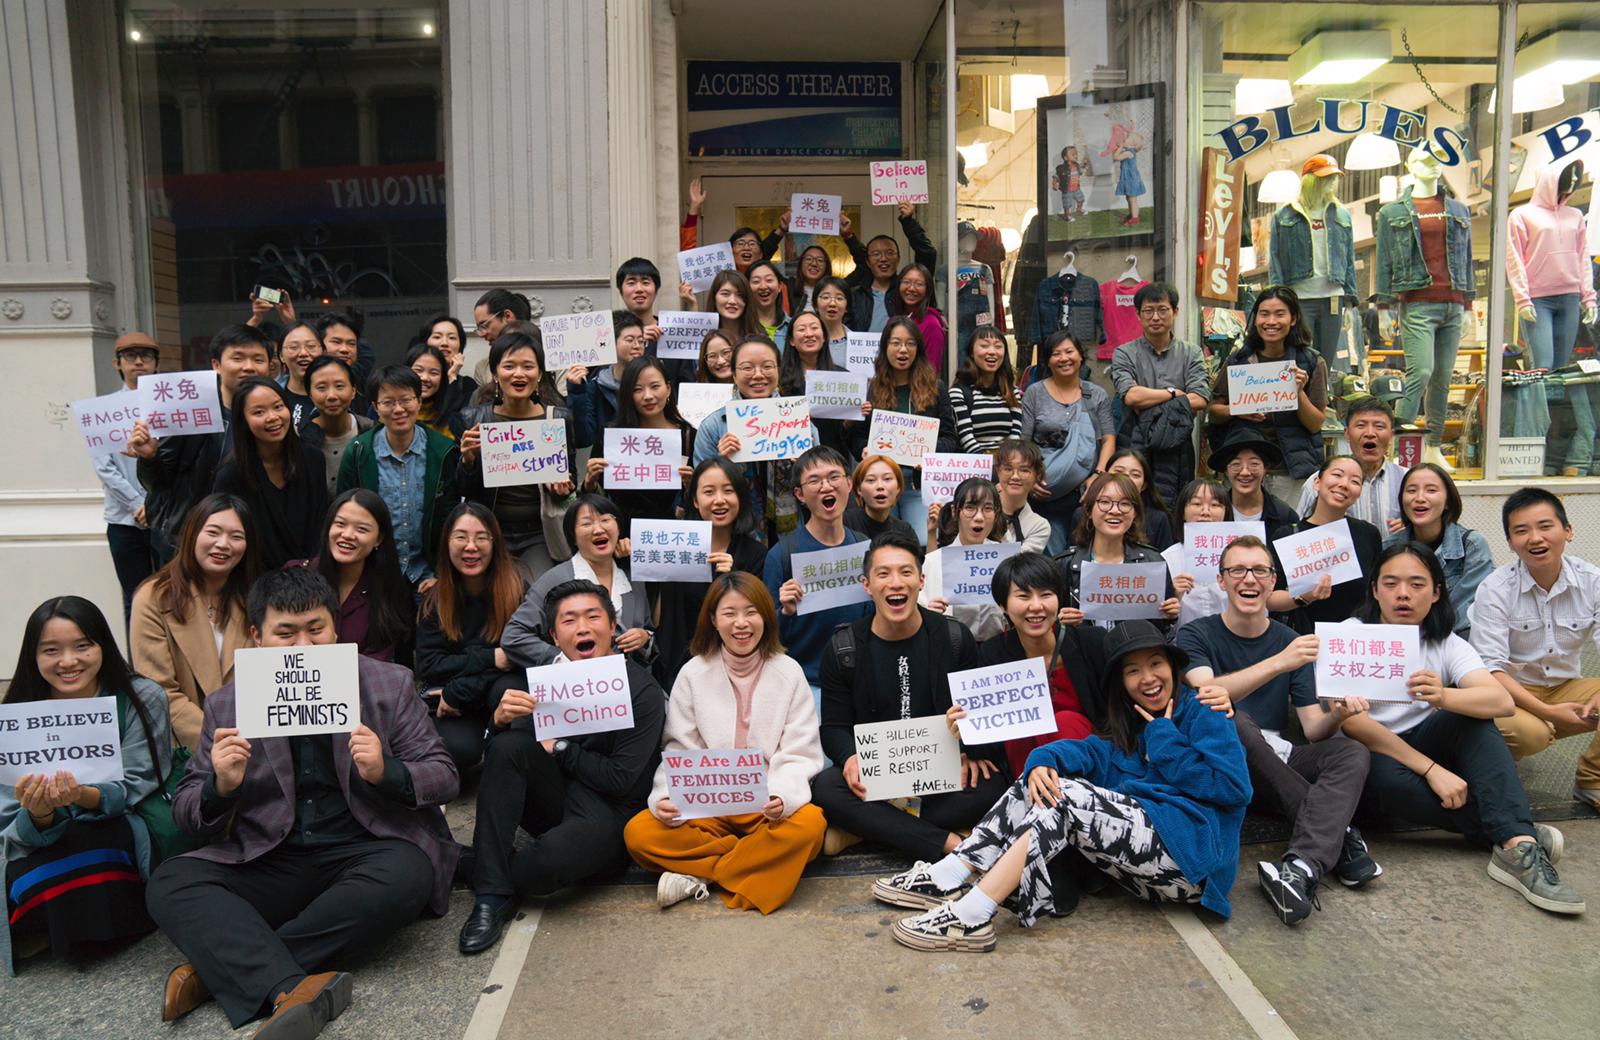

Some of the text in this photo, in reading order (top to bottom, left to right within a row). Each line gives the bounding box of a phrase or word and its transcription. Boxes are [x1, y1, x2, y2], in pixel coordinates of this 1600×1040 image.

[696, 73, 893, 97] ACCESS THEATER
[1213, 97, 1469, 167] BLUES
[817, 148, 869, 156] COMPANY
[872, 161, 926, 177] Believe
[895, 178, 908, 189] in
[873, 188, 928, 205] Survivors
[800, 197, 831, 213] 米兔
[795, 215, 834, 231] 在中国
[685, 250, 727, 268] 我也不是
[542, 313, 606, 334] ME TOO
[672, 317, 686, 325] AM
[687, 318, 705, 326] NOT
[661, 327, 711, 338] PERFEC
[546, 334, 565, 350] IN
[850, 339, 864, 347] WE
[548, 348, 600, 368] CHINA
[1230, 368, 1247, 378] We
[153, 378, 199, 403] 米兔
[813, 381, 860, 394] 我们相信
[809, 396, 862, 407] JINGYAO
[1232, 391, 1297, 406] JING YAO
[148, 407, 213, 430] 在中国
[744, 415, 810, 438] Support
[86, 434, 103, 448] in
[512, 440, 536, 453] ARE
[620, 435, 665, 456] 米兔
[925, 457, 991, 469] We Are All
[1499, 455, 1541, 465] WANTED
[612, 464, 672, 483] 在中国
[640, 530, 700, 546] 我也不是
[964, 549, 998, 561] Here
[1295, 536, 1337, 560] 我相信
[633, 549, 708, 565] 完美受害者
[802, 555, 864, 578] 我们相信
[969, 566, 995, 577] For
[1290, 551, 1351, 580] JINGYAO
[1099, 575, 1147, 589] 我相信
[1086, 592, 1159, 604] JINGYAO
[1328, 638, 1405, 658] 我们都是
[283, 653, 305, 669] WE
[275, 669, 321, 684] SHOULD
[1328, 660, 1405, 680] 女权之声
[961, 669, 1036, 691] I AM NOT A
[275, 685, 323, 702] ALL BE
[533, 677, 625, 703] #Metoo
[956, 683, 1046, 711] PERFECT
[26, 712, 113, 730] BELIEVE
[267, 703, 348, 726] FEMINISTS
[536, 702, 628, 729] in China
[969, 706, 1042, 732] VICTIM
[46, 733, 61, 742] in
[856, 733, 879, 746] WE
[0, 744, 115, 766] SURVIORS
[666, 753, 762, 769] We Are All
[860, 750, 879, 761] WE
[861, 765, 882, 777] WE
[670, 772, 763, 788] FEMINIST
[682, 791, 755, 805] VOICES
